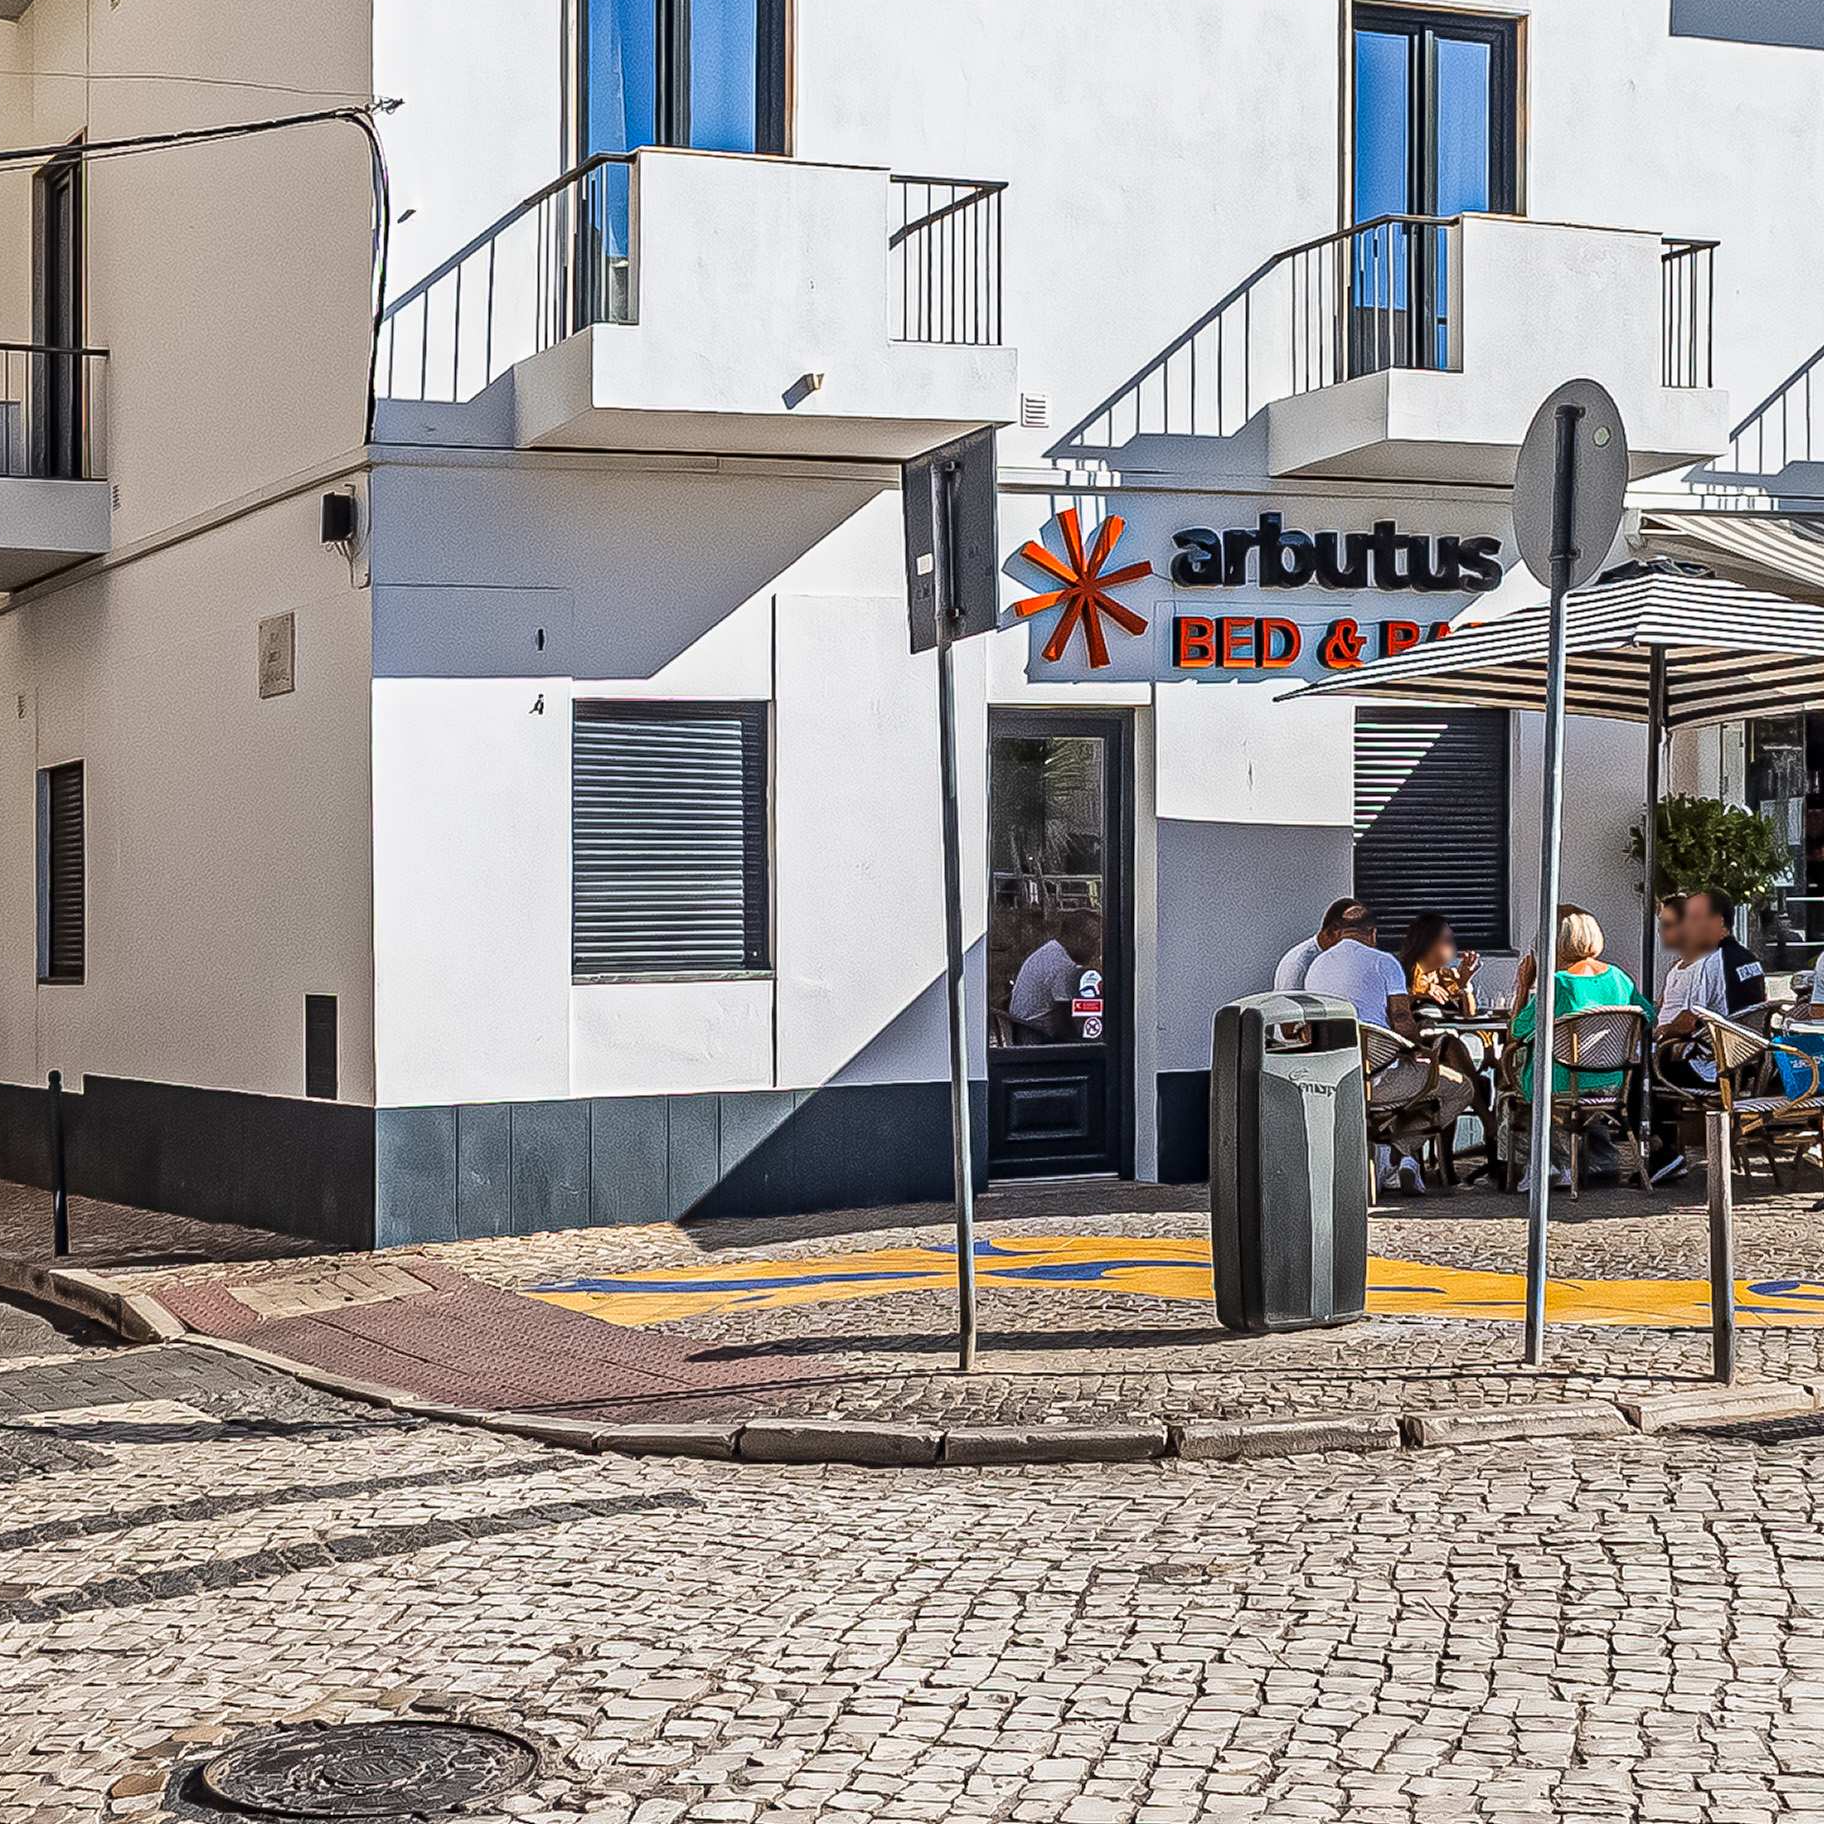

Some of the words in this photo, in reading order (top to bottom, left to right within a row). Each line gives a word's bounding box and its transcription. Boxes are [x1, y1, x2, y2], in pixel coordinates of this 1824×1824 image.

[1171, 511, 1503, 593] arbutus
[1173, 616, 1301, 669] BED
[1318, 617, 1366, 669] &
